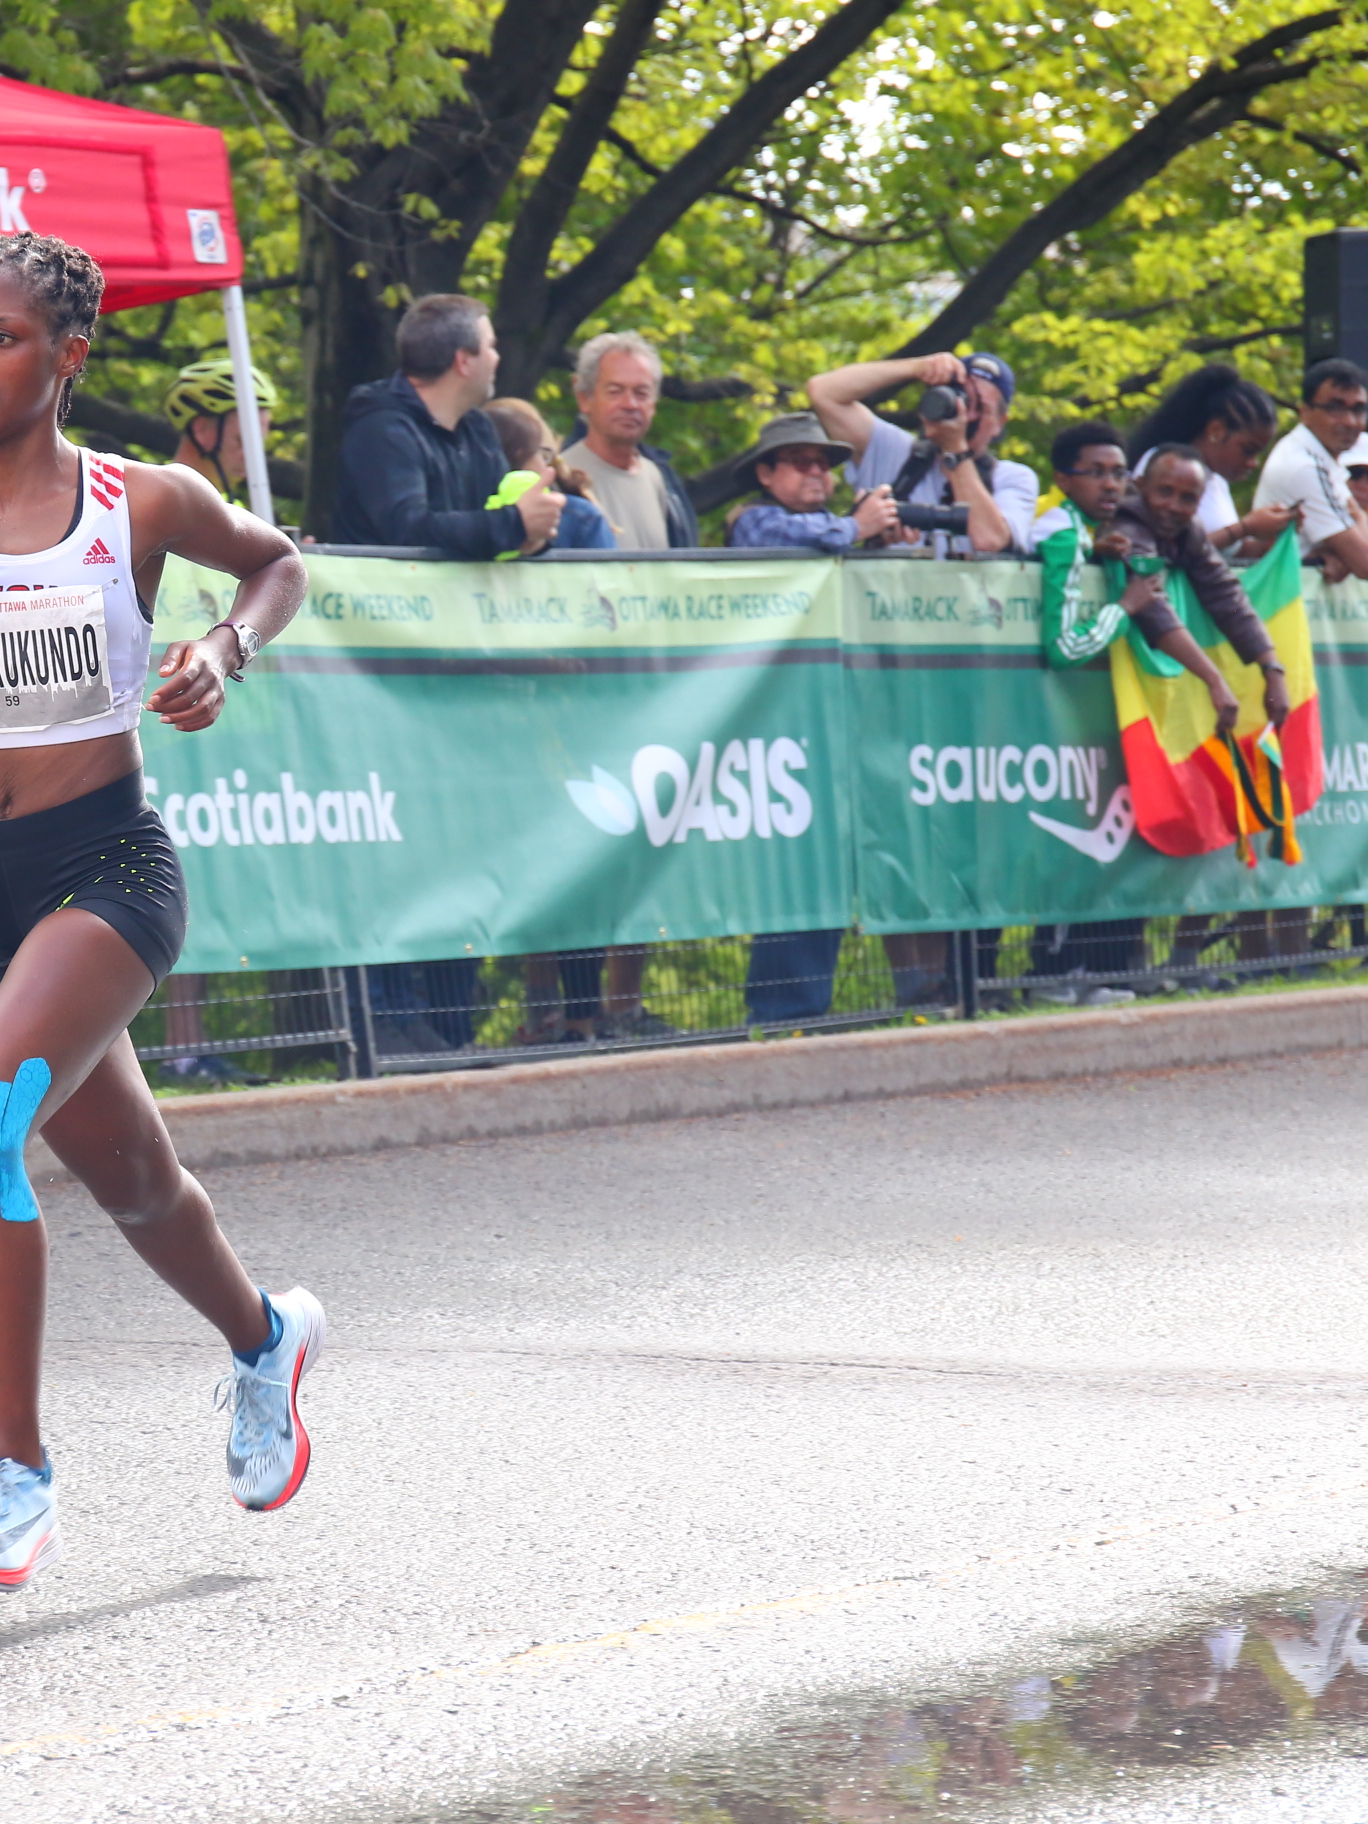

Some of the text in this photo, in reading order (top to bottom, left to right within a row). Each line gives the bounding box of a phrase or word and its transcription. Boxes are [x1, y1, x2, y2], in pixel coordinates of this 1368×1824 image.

[82, 553, 116, 565] adidas
[30, 595, 85, 612] MARATHON
[300, 592, 434, 622] ACE WEEKEND
[473, 591, 811, 624] TAMARACK OTTAWA RACE WEEKEND
[866, 590, 960, 622] TAMARACK
[4, 695, 21, 707] 59
[630, 736, 813, 848] OASIS
[909, 743, 1100, 817] saucony
